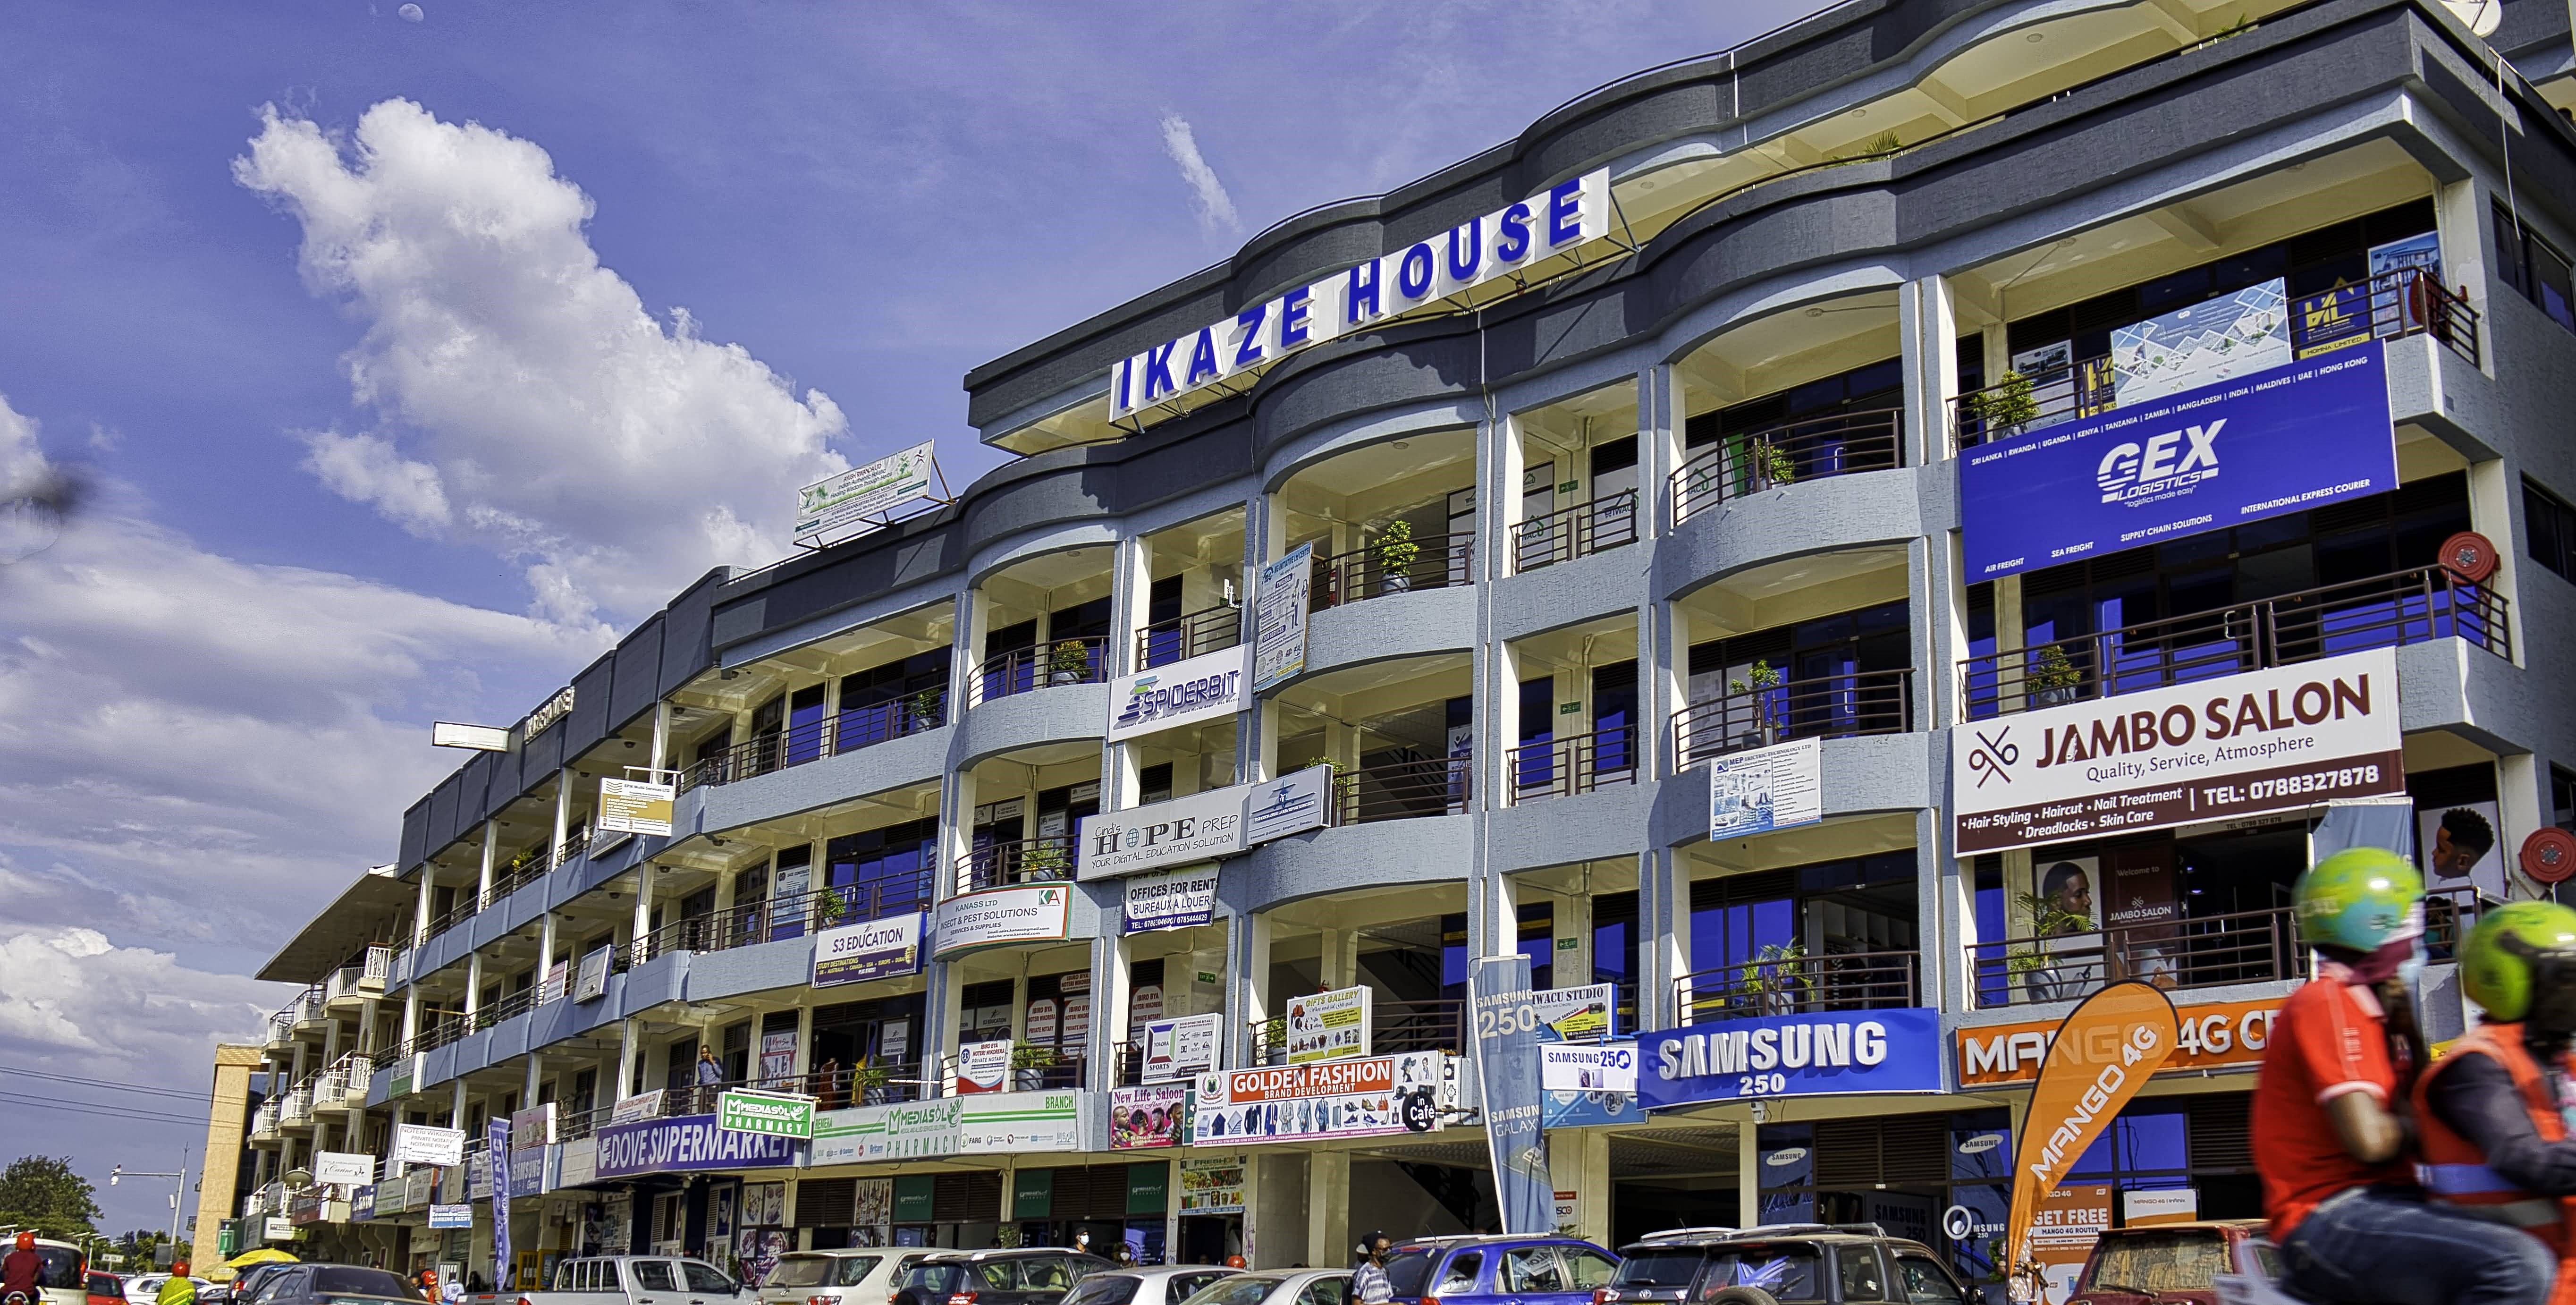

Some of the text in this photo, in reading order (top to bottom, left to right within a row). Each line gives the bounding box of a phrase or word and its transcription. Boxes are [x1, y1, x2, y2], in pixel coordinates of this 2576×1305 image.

[1121, 178, 1582, 410] IKAZE HOUSE
[1982, 452, 2002, 463] LANKA
[2008, 443, 2036, 457] RWANDA
[2043, 434, 2071, 447] UGANDA
[2077, 427, 2099, 439] KENYA
[2105, 417, 2138, 431] TANZANIA
[2144, 408, 2170, 421] ZAMBIA
[2176, 394, 2222, 412] BANGLADESH
[2229, 388, 2249, 398] INDIA
[2255, 377, 2290, 391] MALDIVES
[2297, 371, 2313, 381] UAE
[2320, 364, 2343, 376] HONG
[2344, 356, 2368, 369] KONG
[2097, 418, 2227, 491] GEX
[2117, 471, 2202, 500] LOGISTICS
[2154, 491, 2176, 501] made
[2241, 479, 2370, 514] INTERNATIONAL EXPRESS COURIER
[2120, 514, 2213, 542] SUPPLY CHAIN SOLUTIONS
[2051, 541, 2094, 558] SEA FREIGHT
[1984, 558, 2024, 573] AIR FREIGHT
[1144, 670, 1239, 715] SPIDERBIT
[2036, 673, 2372, 769] JAMBO SALON
[1729, 757, 1744, 765] MEP
[2086, 736, 2314, 782] Quality, Service, Atmosphere
[2204, 765, 2379, 806] TEL: 0788327878
[1968, 788, 2183, 830] Hair Styling Haircut Nail Treatment
[1095, 822, 1122, 838] Cindi's
[1201, 814, 1239, 834] PREP
[2026, 811, 2154, 839] Dreadlocks Skin Care
[1091, 832, 1234, 869] YOUR DIGITAL EDUCATION SOLUTION
[2116, 867, 2150, 877] Welcome
[1131, 878, 1216, 900] OFFICES FOR RENT
[955, 900, 983, 912] KANASS
[1134, 899, 1172, 914] BUREAUX
[1182, 895, 1210, 908] LOUER
[2110, 910, 2140, 921] JAMBO
[2142, 906, 2171, 916] SALON
[964, 913, 982, 924] PEST
[984, 908, 1038, 921] SOLUTIONS
[950, 926, 969, 935] SERVICES
[975, 922, 1001, 930] SUPPLIES
[832, 927, 904, 952] S3 EDUCATION
[830, 958, 859, 967] DESTINATIONS
[1137, 994, 1149, 1002] IBIRO
[1306, 990, 1360, 1007] GIFTS GALLERY
[1478, 989, 1533, 1008] SAMSUNG
[1566, 987, 1604, 1001] STUDIO
[1479, 1004, 1536, 1039] 250
[1562, 1008, 1579, 1019] SERVICES
[2177, 1014, 2232, 1055] 4G
[1658, 1021, 1887, 1081] SAMSUNG
[2122, 1025, 2157, 1068] 4G
[1548, 1051, 1599, 1064] SAMSUNG
[1233, 1062, 1391, 1091] GOLDEN FASHION
[1739, 1074, 1786, 1095] 250
[1114, 1087, 1184, 1104] New Life Saloon
[1265, 1083, 1355, 1099] BRAND DEVELOPMENT
[1417, 1096, 1425, 1105] in
[740, 1103, 791, 1117] MEDIASOL
[1046, 1095, 1073, 1110] BRANCH
[901, 1104, 947, 1126] MEDIASOL
[1410, 1105, 1436, 1121] Café
[1491, 1104, 1542, 1123] SAMSUN
[726, 1116, 803, 1135] PHARMACY
[815, 1117, 833, 1129] REMERA
[2029, 1064, 2126, 1182] MANGO
[610, 1124, 790, 1169] DOVE SUPERMARKET
[887, 1134, 958, 1158] PHARMACY
[1965, 1139, 1998, 1149] SAMSUNG
[1771, 1152, 1802, 1161] SAMSUNG
[512, 1159, 541, 1182] SAMSUNG
[1875, 1203, 1926, 1224] SAMSUNG
[2034, 1208, 2108, 1226] GET FREE
